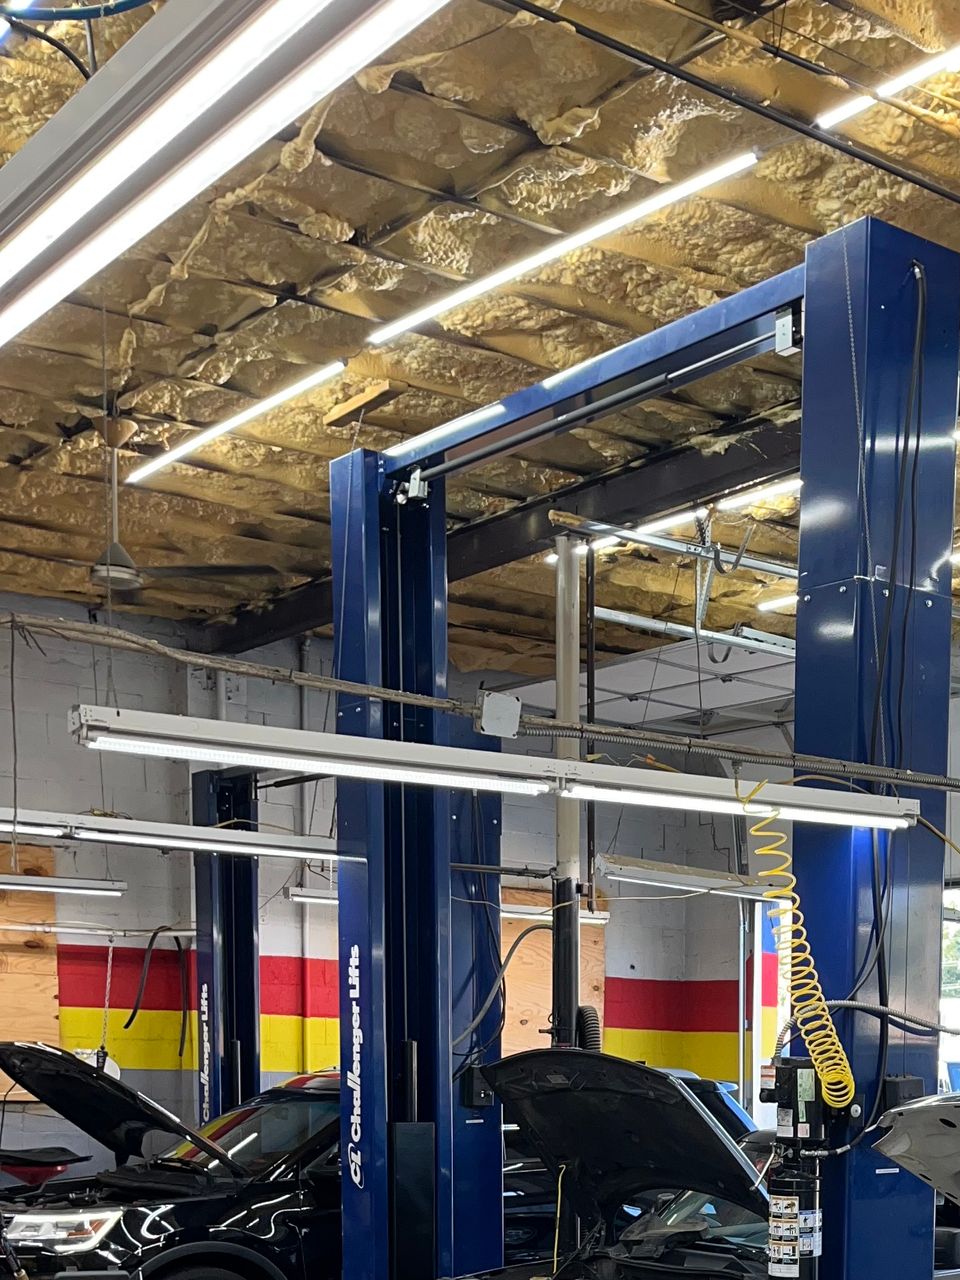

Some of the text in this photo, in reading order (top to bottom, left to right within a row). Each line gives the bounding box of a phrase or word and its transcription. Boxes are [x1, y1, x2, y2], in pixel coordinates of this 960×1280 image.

[349, 944, 359, 998] Lifts
[200, 983, 211, 1122] Challenger Lifts
[347, 1001, 363, 1143] Challenger
